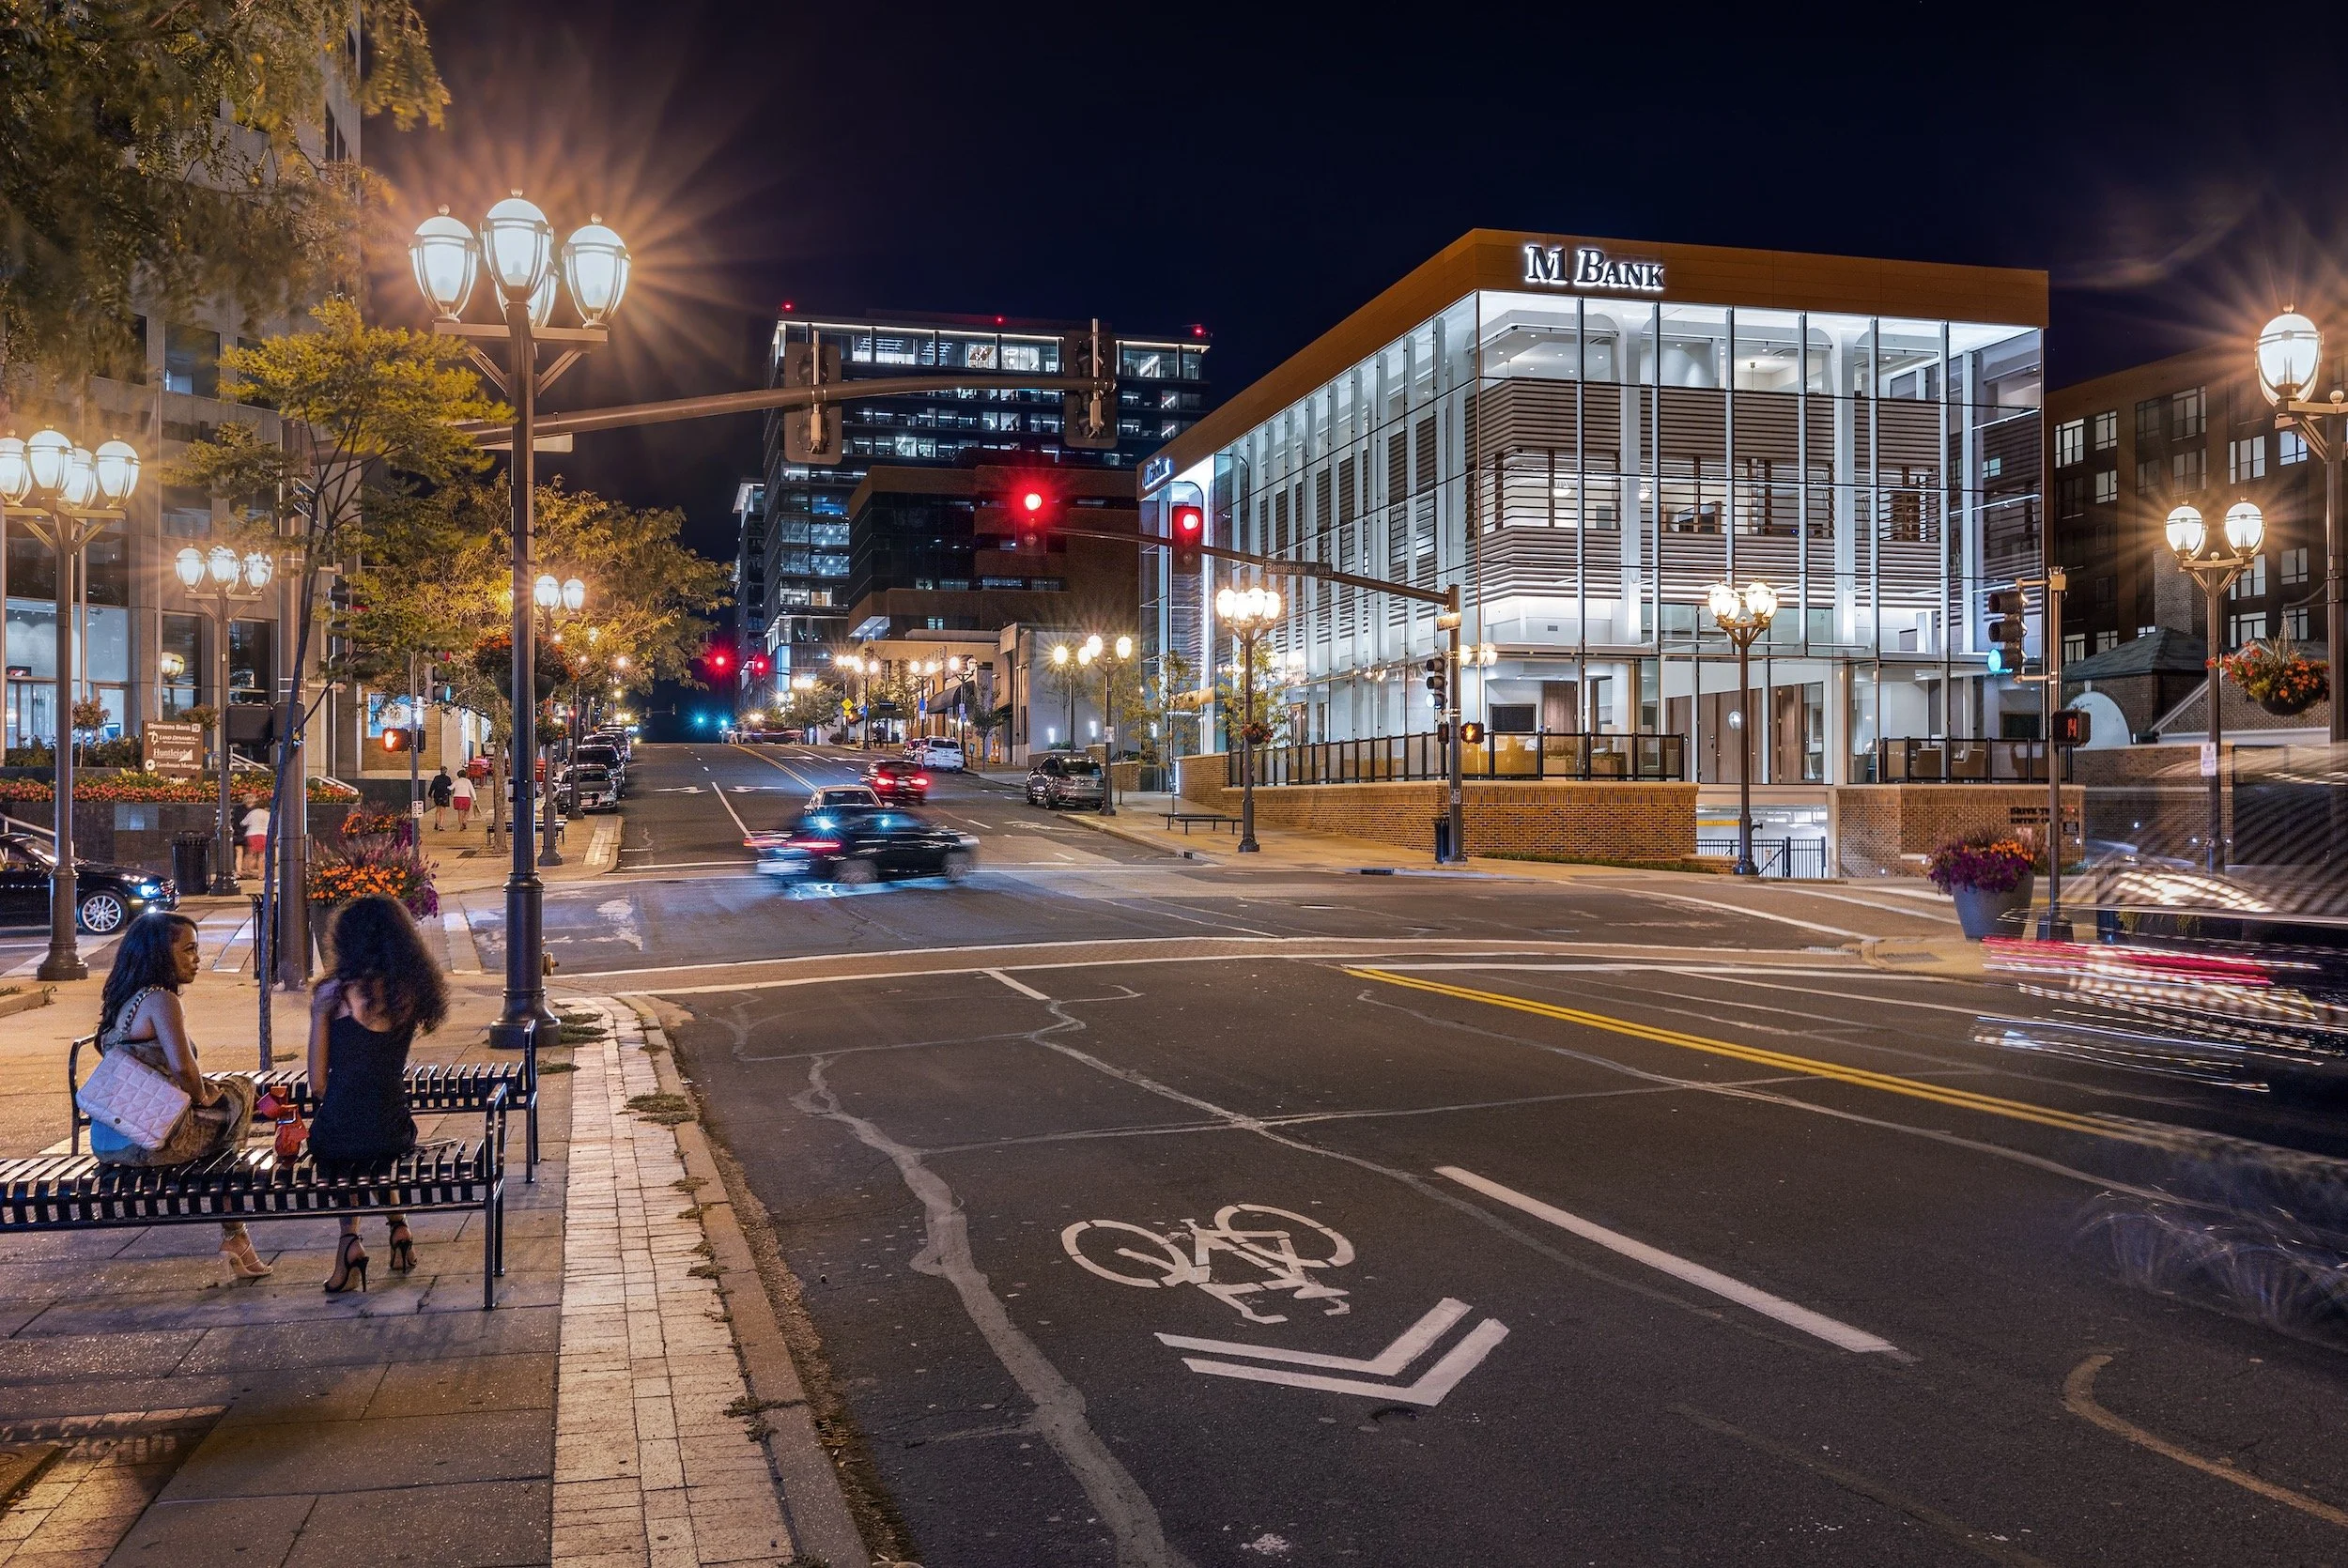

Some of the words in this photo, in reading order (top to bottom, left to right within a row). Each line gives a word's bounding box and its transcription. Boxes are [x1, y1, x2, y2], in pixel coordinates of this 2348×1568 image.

[1574, 249, 1666, 288] BANK
[1265, 562, 1307, 575] Bemiston
[1315, 564, 1331, 576] Ave
